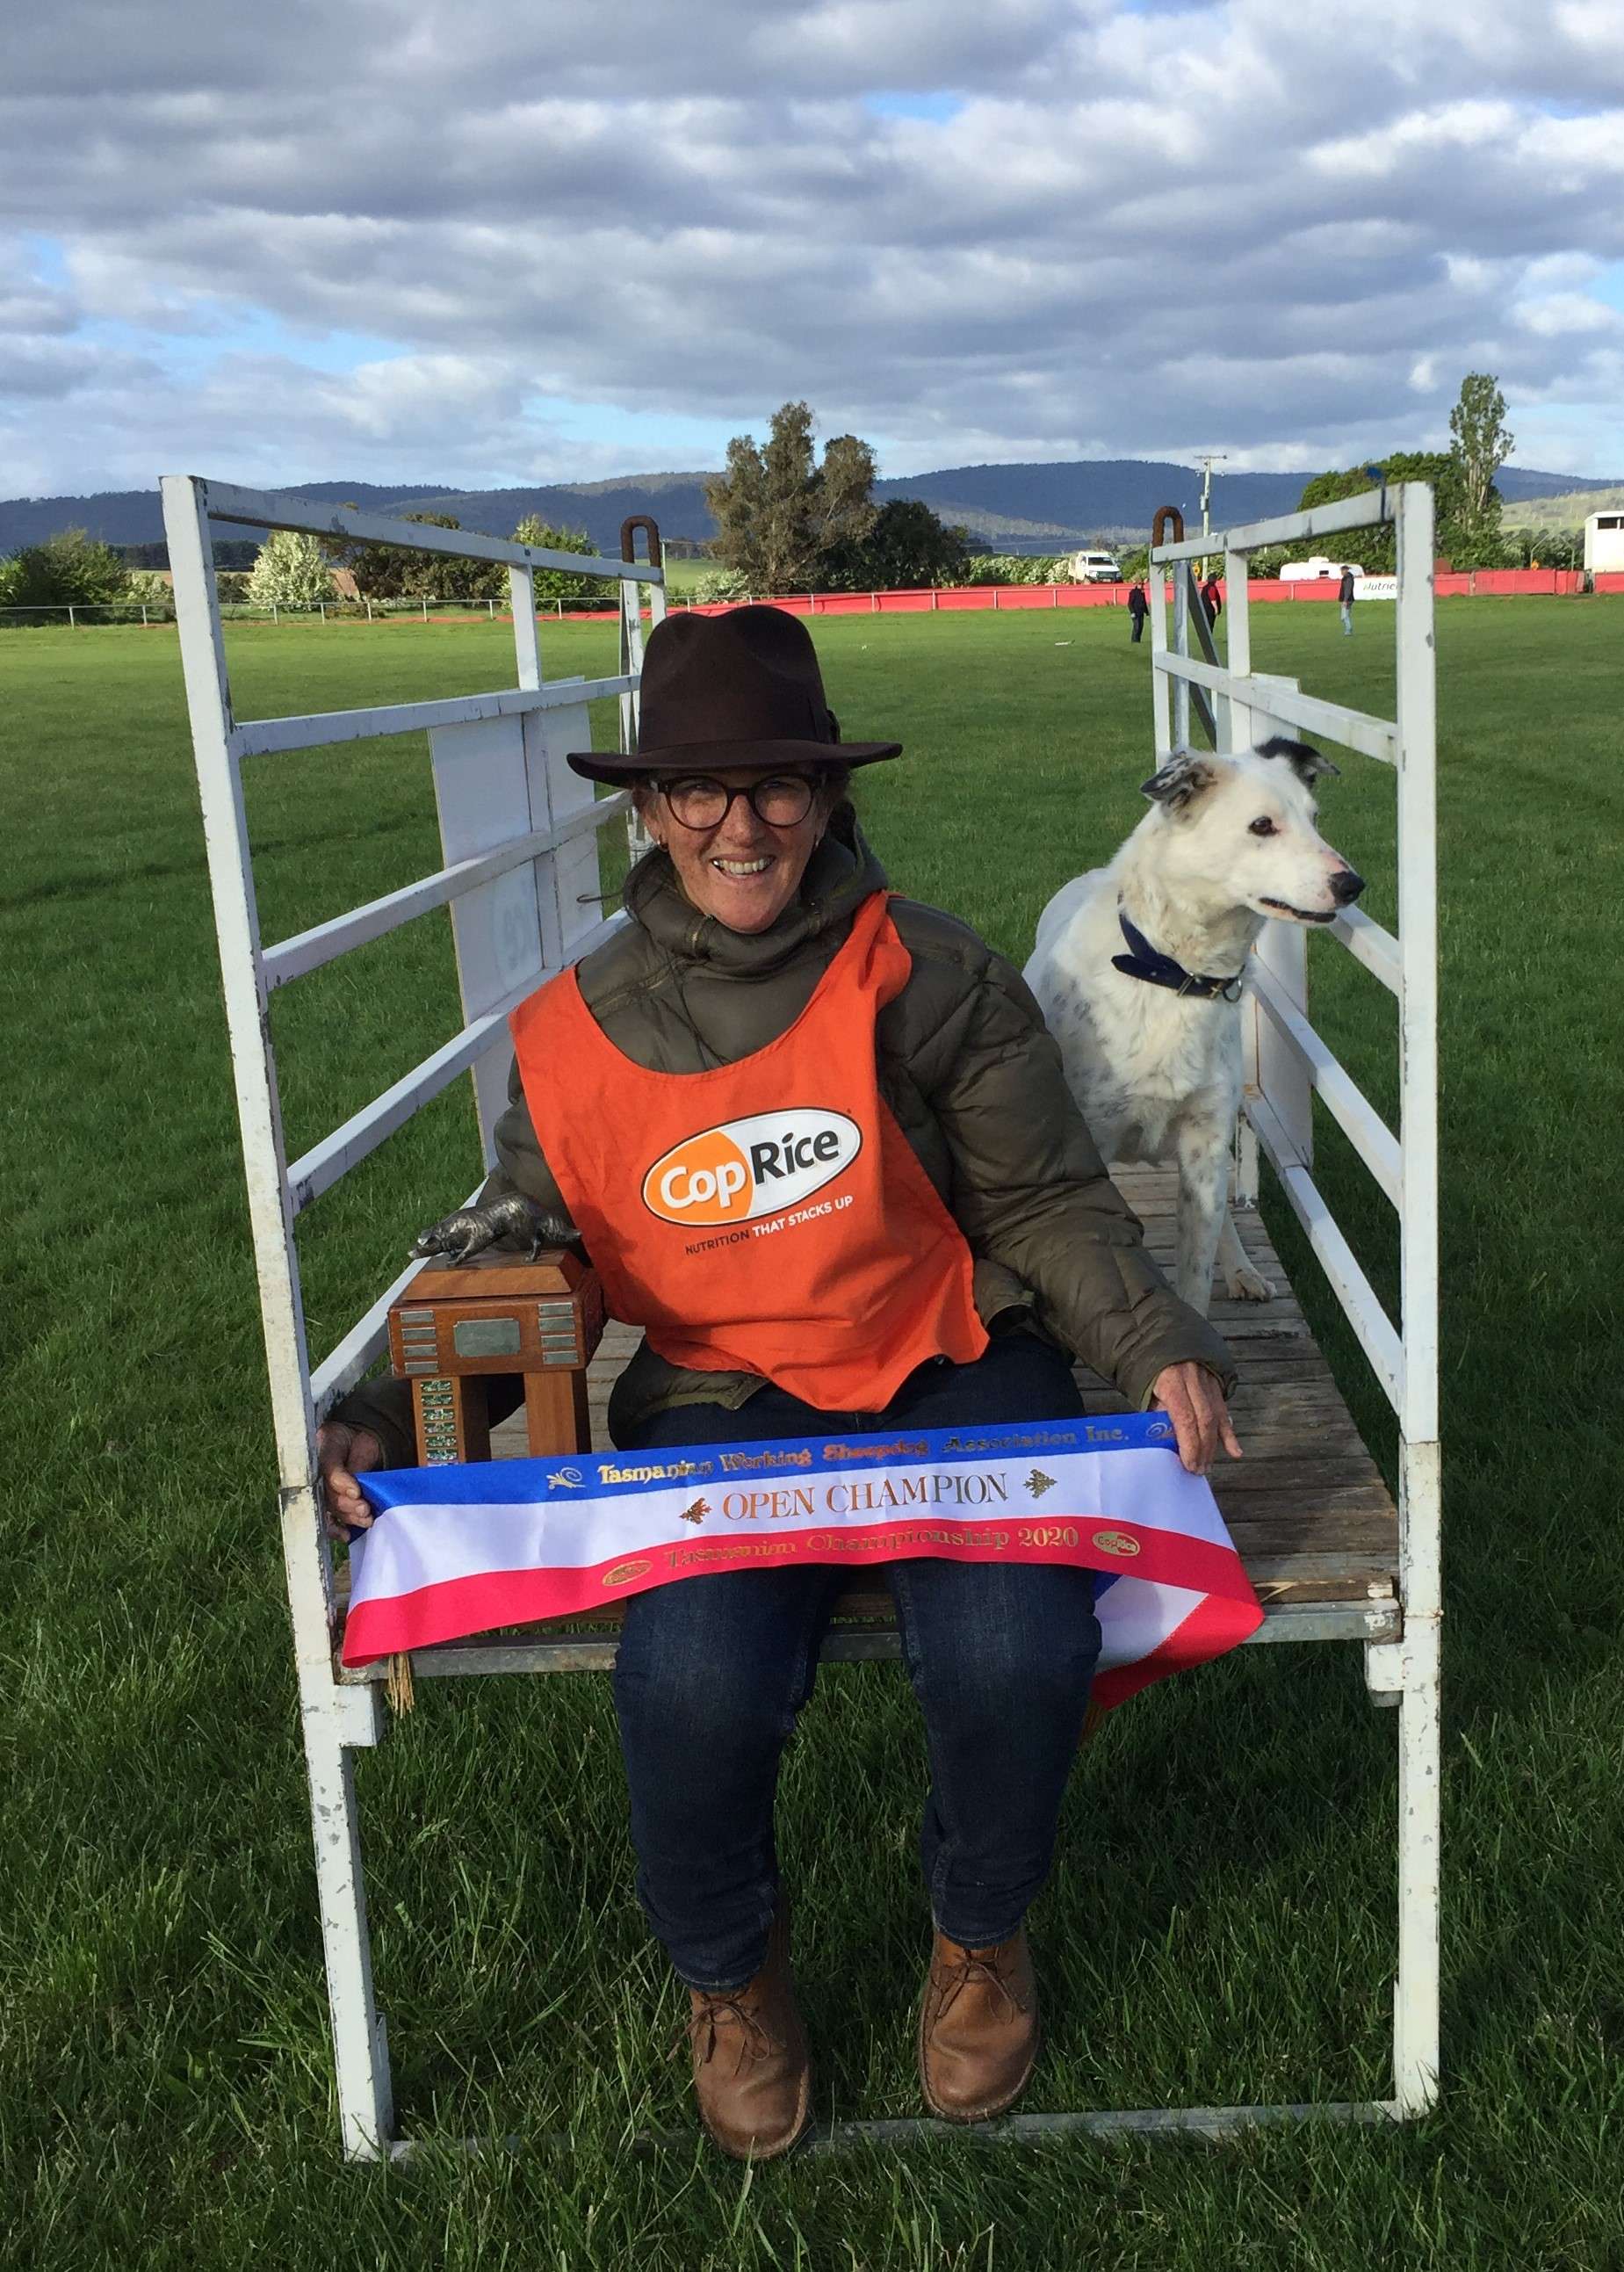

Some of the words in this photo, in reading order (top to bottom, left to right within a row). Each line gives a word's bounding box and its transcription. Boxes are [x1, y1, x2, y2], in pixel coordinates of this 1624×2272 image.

[660, 1129, 840, 1208] CopRice
[685, 1229, 749, 1255] NUTRITION
[752, 1218, 786, 1238] THAT
[788, 1202, 833, 1226] STACKS
[834, 1195, 854, 1211] UP
[597, 1459, 714, 1485] Tasmanian
[942, 1431, 1077, 1453] Association
[1085, 1425, 1130, 1441] Inc.
[723, 1486, 815, 1521] OPEN
[826, 1472, 1009, 1514] CHAMPION
[807, 1527, 1009, 1552] Championship
[1018, 1526, 1080, 1548] 2020
